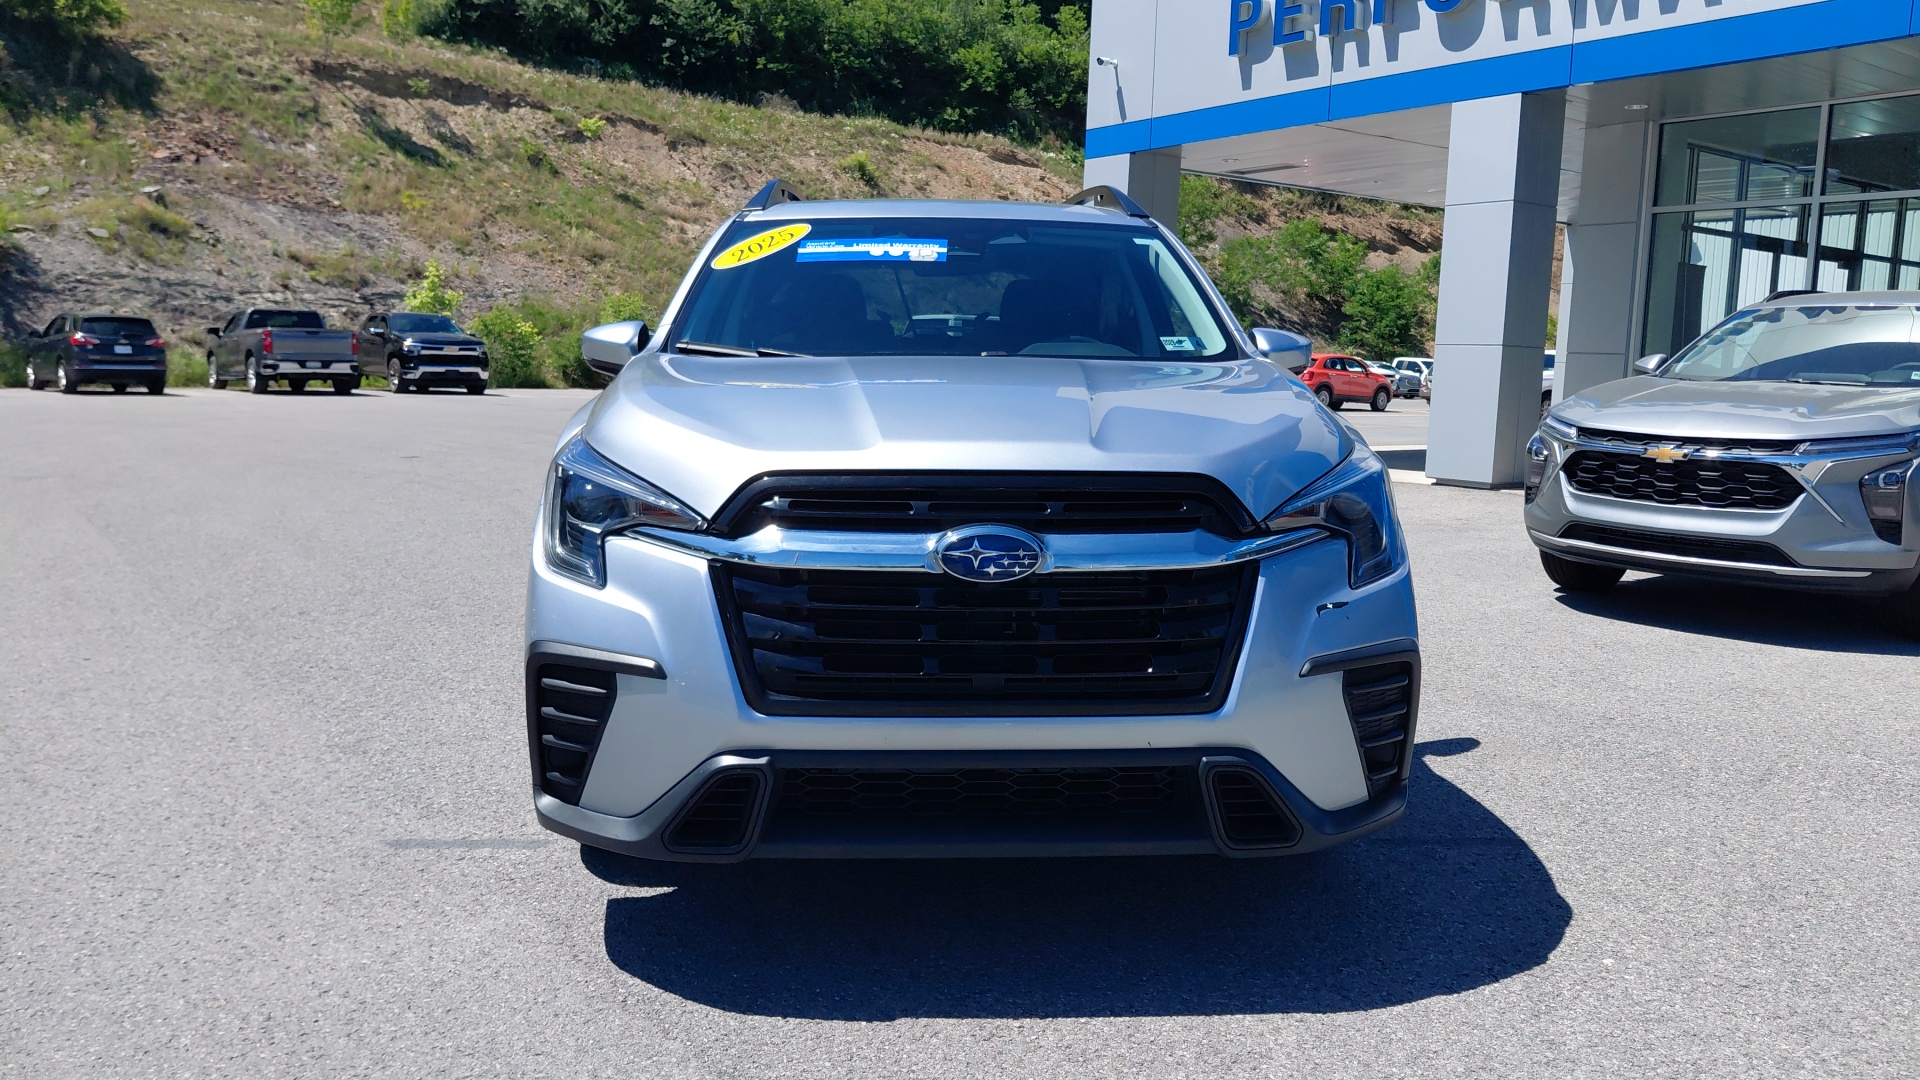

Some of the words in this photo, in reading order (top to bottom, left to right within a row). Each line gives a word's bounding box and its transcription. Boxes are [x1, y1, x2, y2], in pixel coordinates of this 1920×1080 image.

[731, 228, 795, 263] 2025
[853, 242, 890, 250] Limited
[891, 242, 940, 250] Warranty
